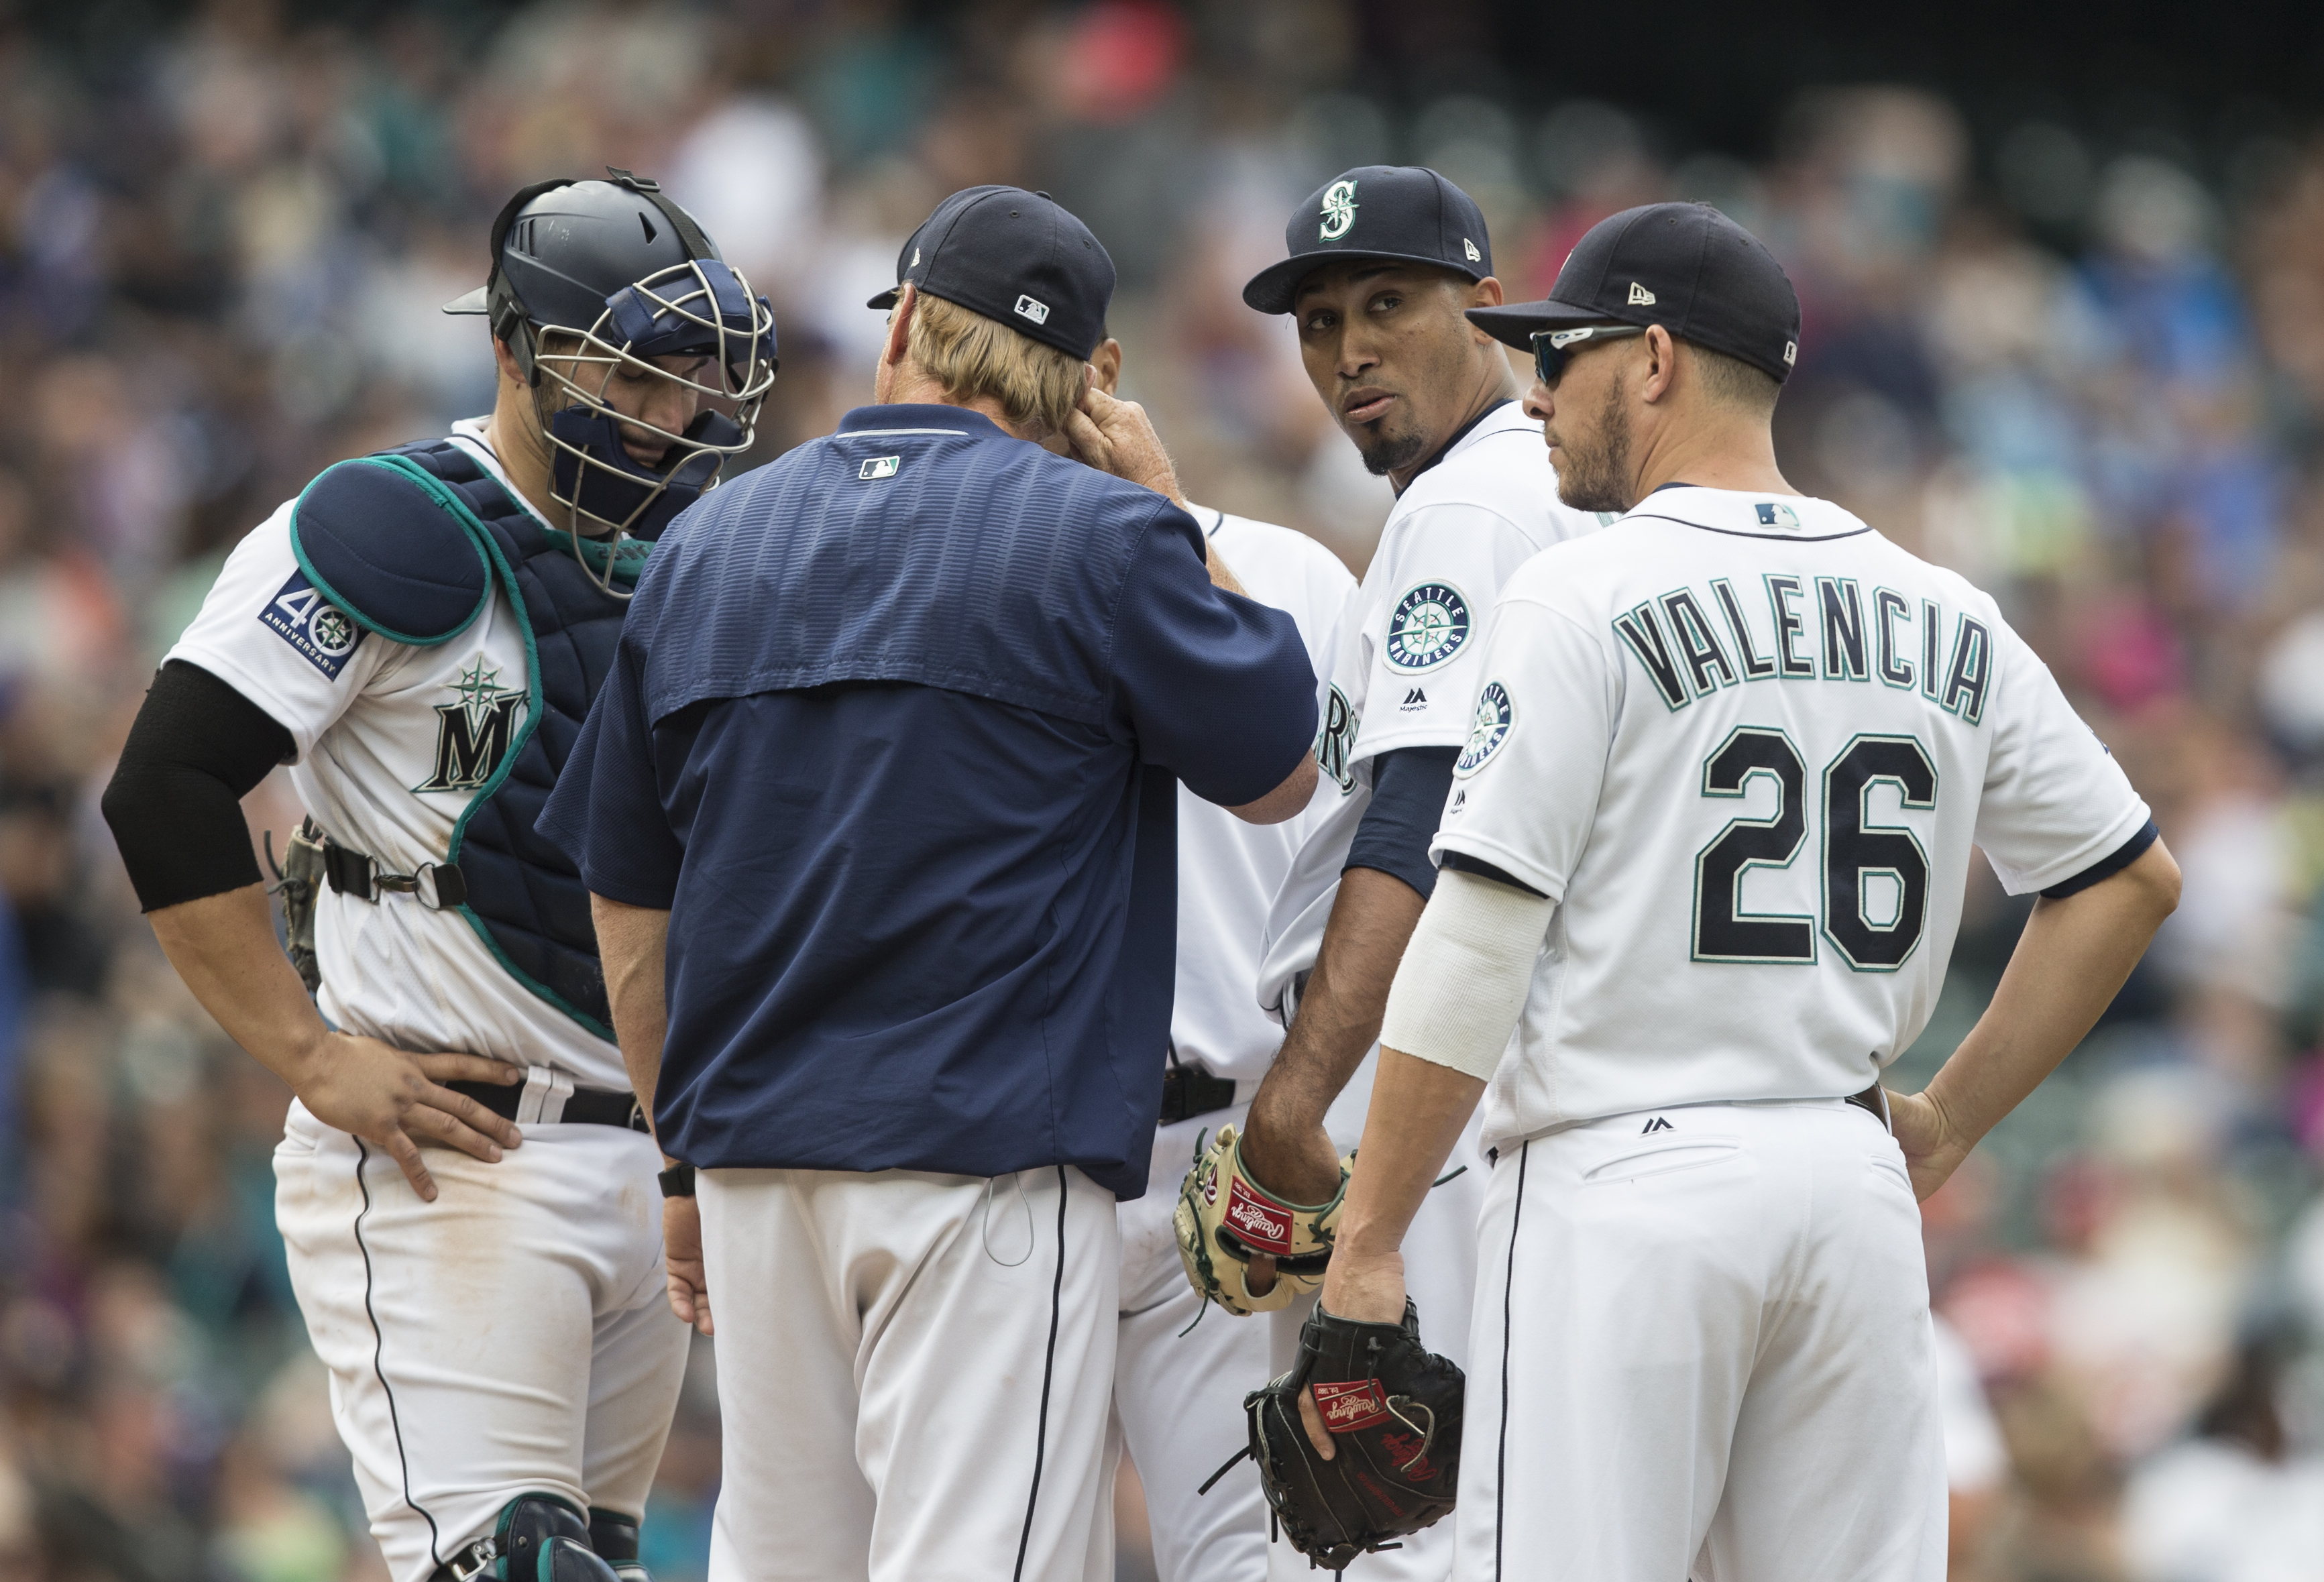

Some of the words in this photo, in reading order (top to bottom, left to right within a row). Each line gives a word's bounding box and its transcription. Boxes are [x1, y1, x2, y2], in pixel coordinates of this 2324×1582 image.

[1319, 180, 1360, 243] S
[1395, 587, 1464, 622] SEATTLE
[265, 612, 336, 673] ANNIVERSARY
[1390, 634, 1462, 665] MARINERS
[1612, 573, 1993, 727] VALENCIA
[1399, 704, 1428, 713] Majestic
[1690, 725, 1938, 973] 26
[1231, 1202, 1284, 1239] Rawlings
[1327, 1396, 1380, 1420] Rawlings
